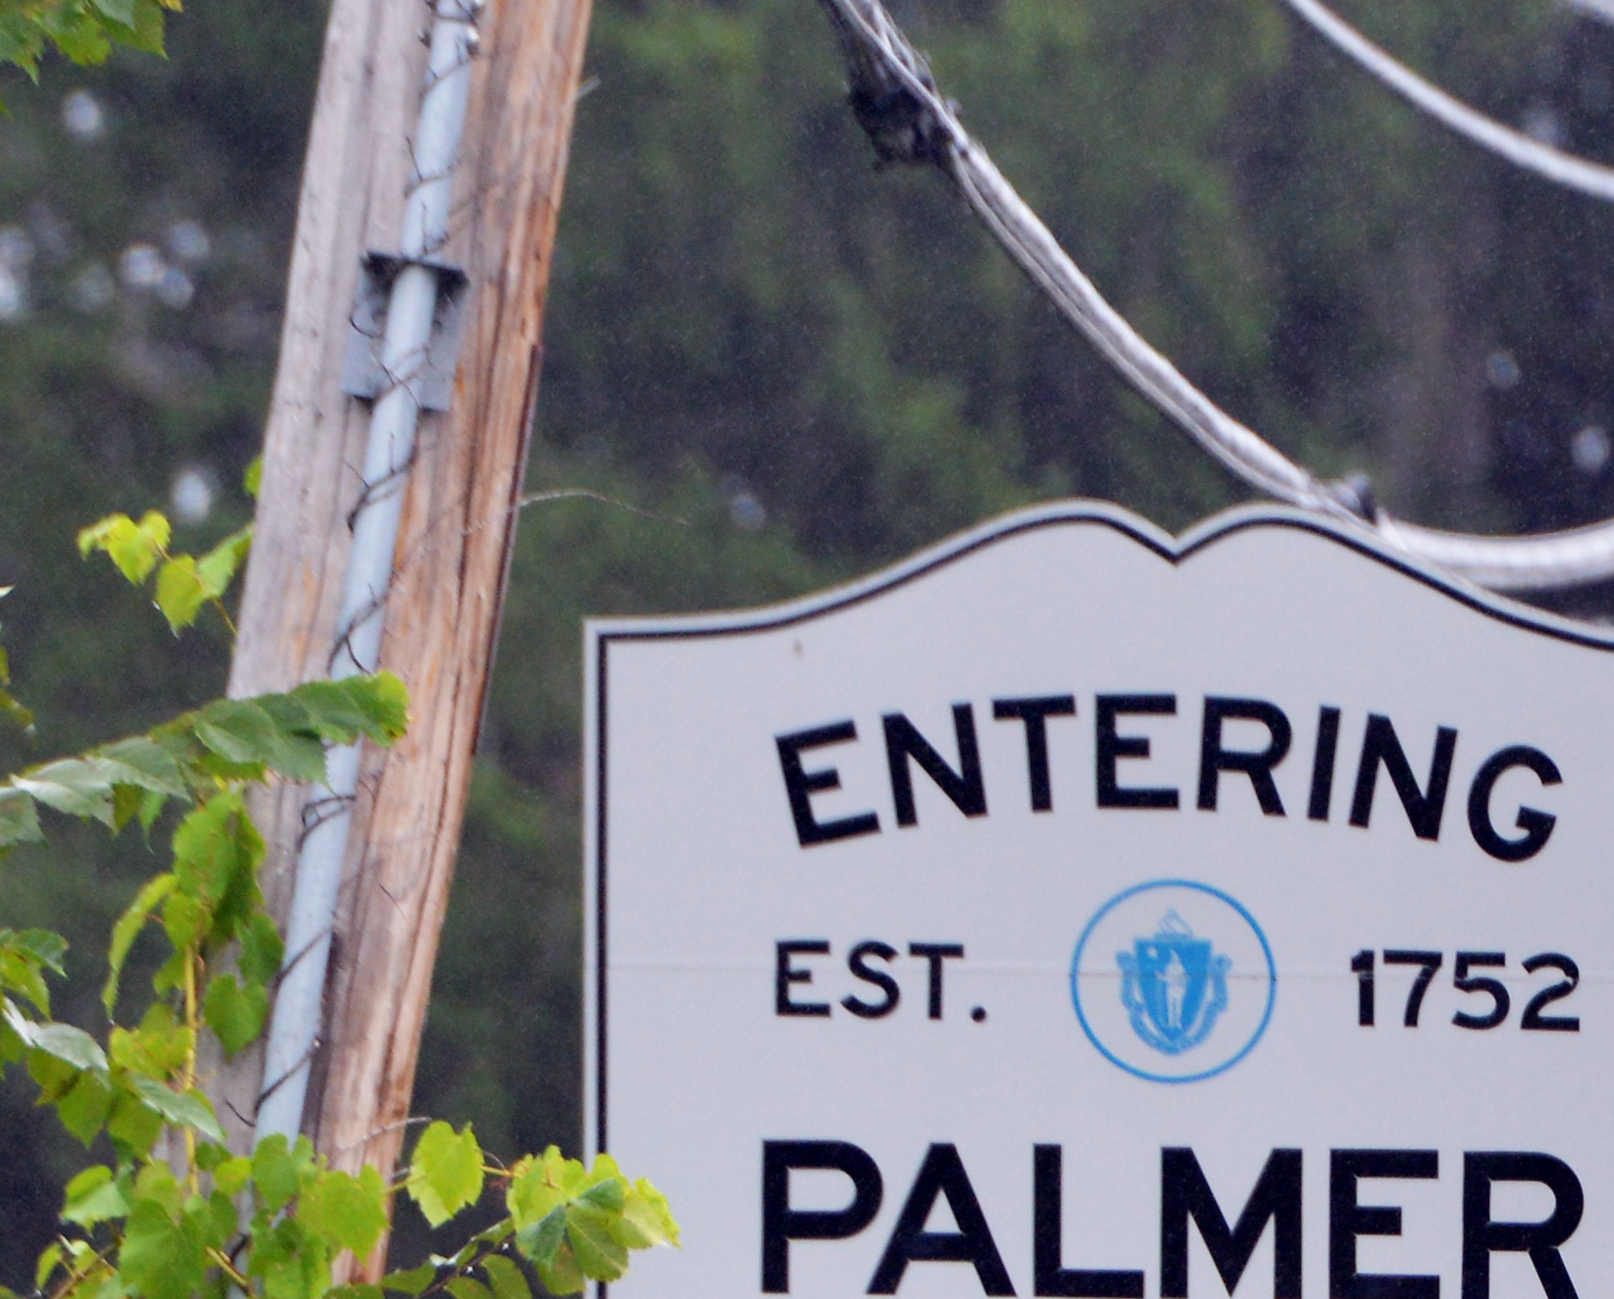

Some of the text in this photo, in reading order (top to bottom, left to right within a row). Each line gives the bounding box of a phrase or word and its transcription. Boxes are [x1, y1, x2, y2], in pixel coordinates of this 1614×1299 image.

[774, 692, 1564, 863] ENTERING
[774, 939, 1581, 1032] EST. 1752
